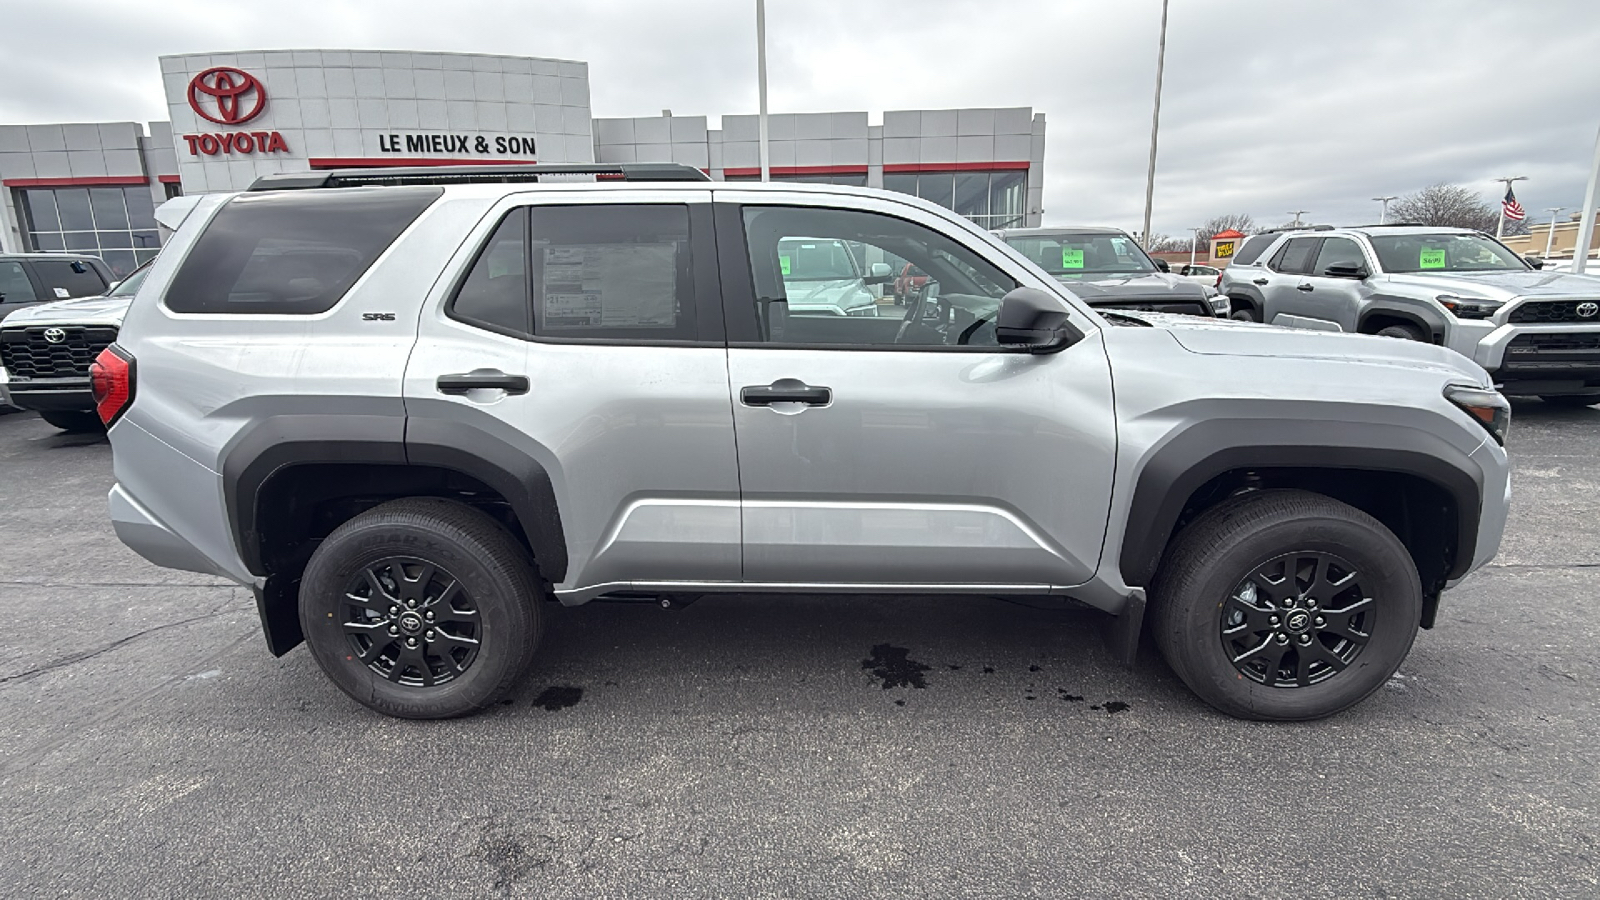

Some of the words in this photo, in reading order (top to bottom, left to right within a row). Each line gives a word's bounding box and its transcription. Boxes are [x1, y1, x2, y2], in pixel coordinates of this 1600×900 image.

[183, 131, 289, 155] TOYOTA
[379, 134, 402, 153] LE
[405, 134, 471, 154] MIEUX
[474, 135, 491, 154] &
[495, 136, 537, 155] SON
